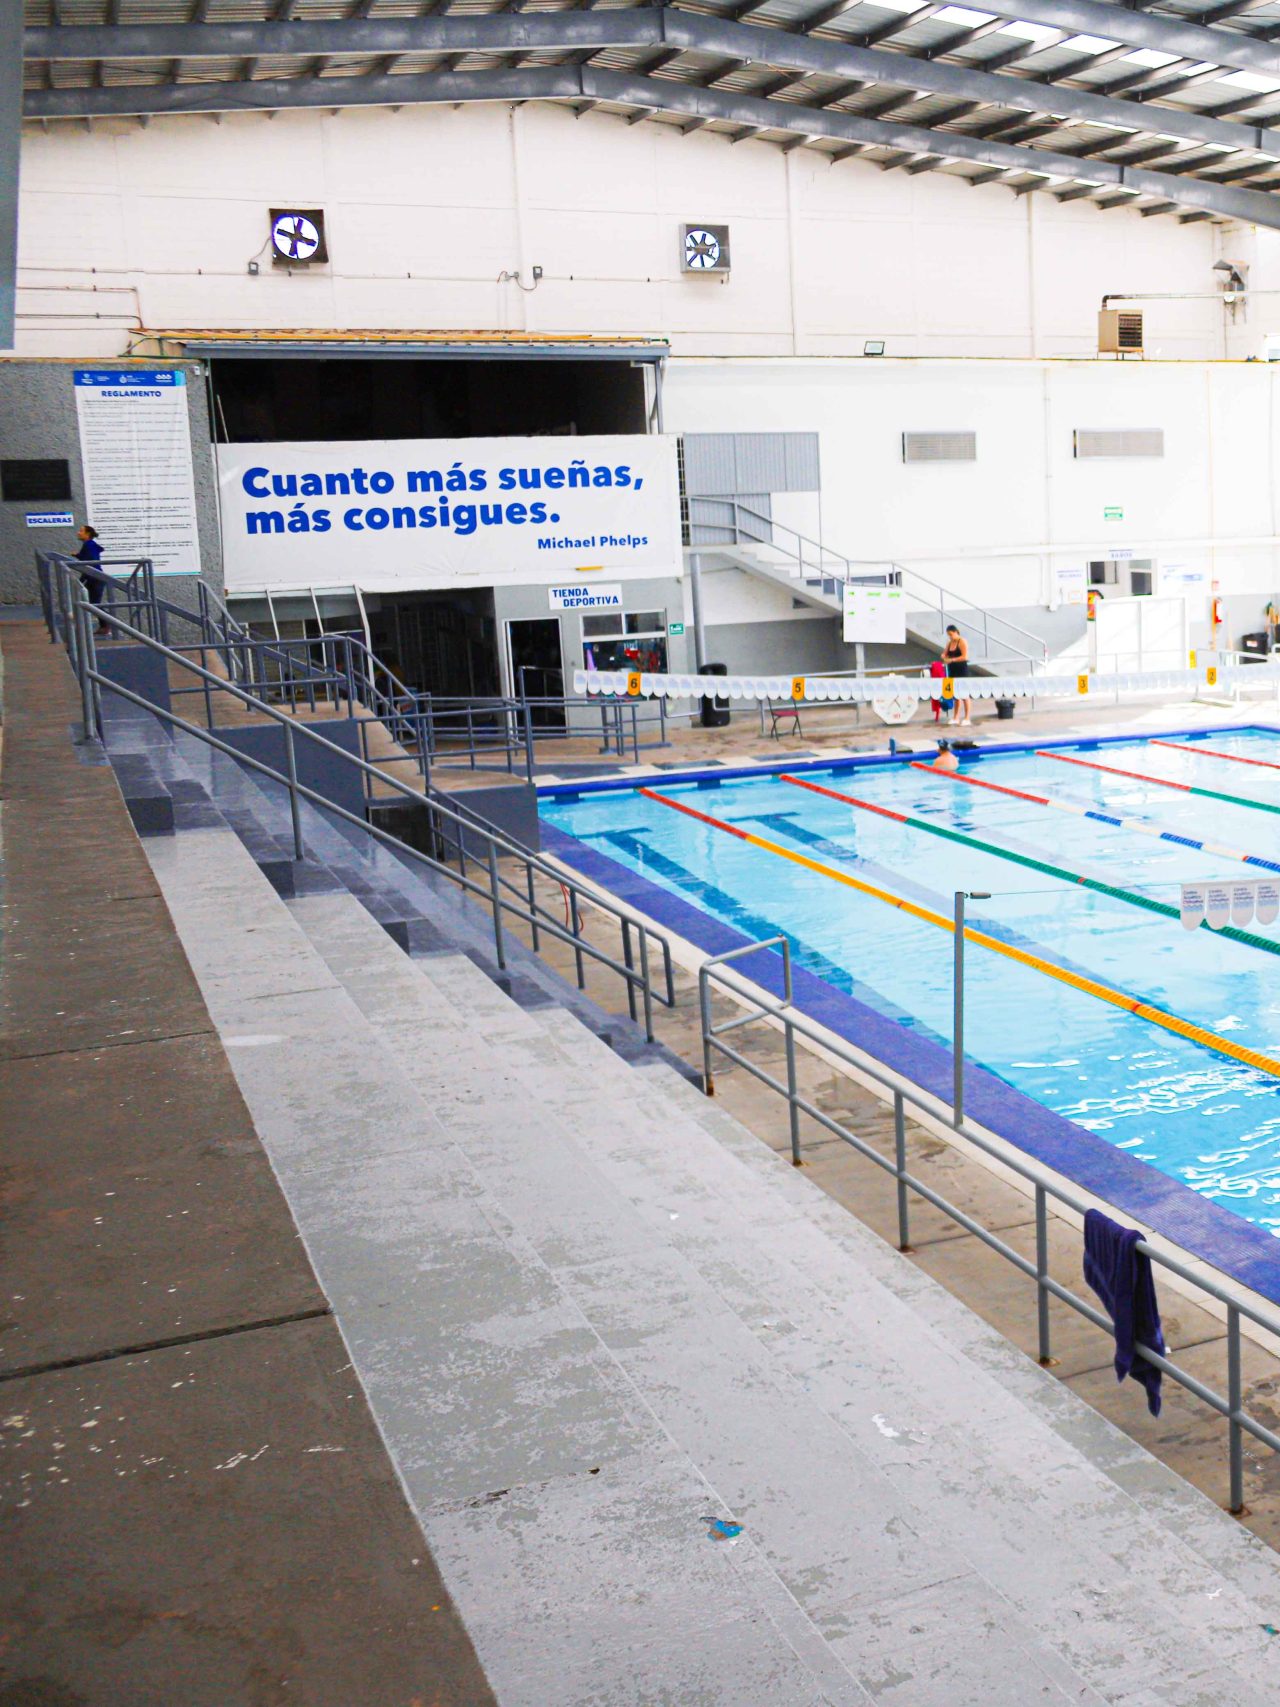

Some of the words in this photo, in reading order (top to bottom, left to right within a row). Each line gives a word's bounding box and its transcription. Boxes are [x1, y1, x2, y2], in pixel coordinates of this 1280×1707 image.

[242, 466, 395, 499] Cuanto
[407, 462, 488, 493] más
[499, 460, 645, 491] sueñas,
[246, 503, 332, 534] más
[343, 496, 561, 535] consigues.
[537, 537, 595, 550] Michael
[600, 535, 649, 550] Phelps
[552, 587, 589, 598] TIENDA
[563, 596, 619, 608] DEPORTIVA
[630, 678, 637, 689] 6
[795, 682, 801, 693] 5
[945, 683, 951, 692] 4
[1080, 679, 1086, 689] 3
